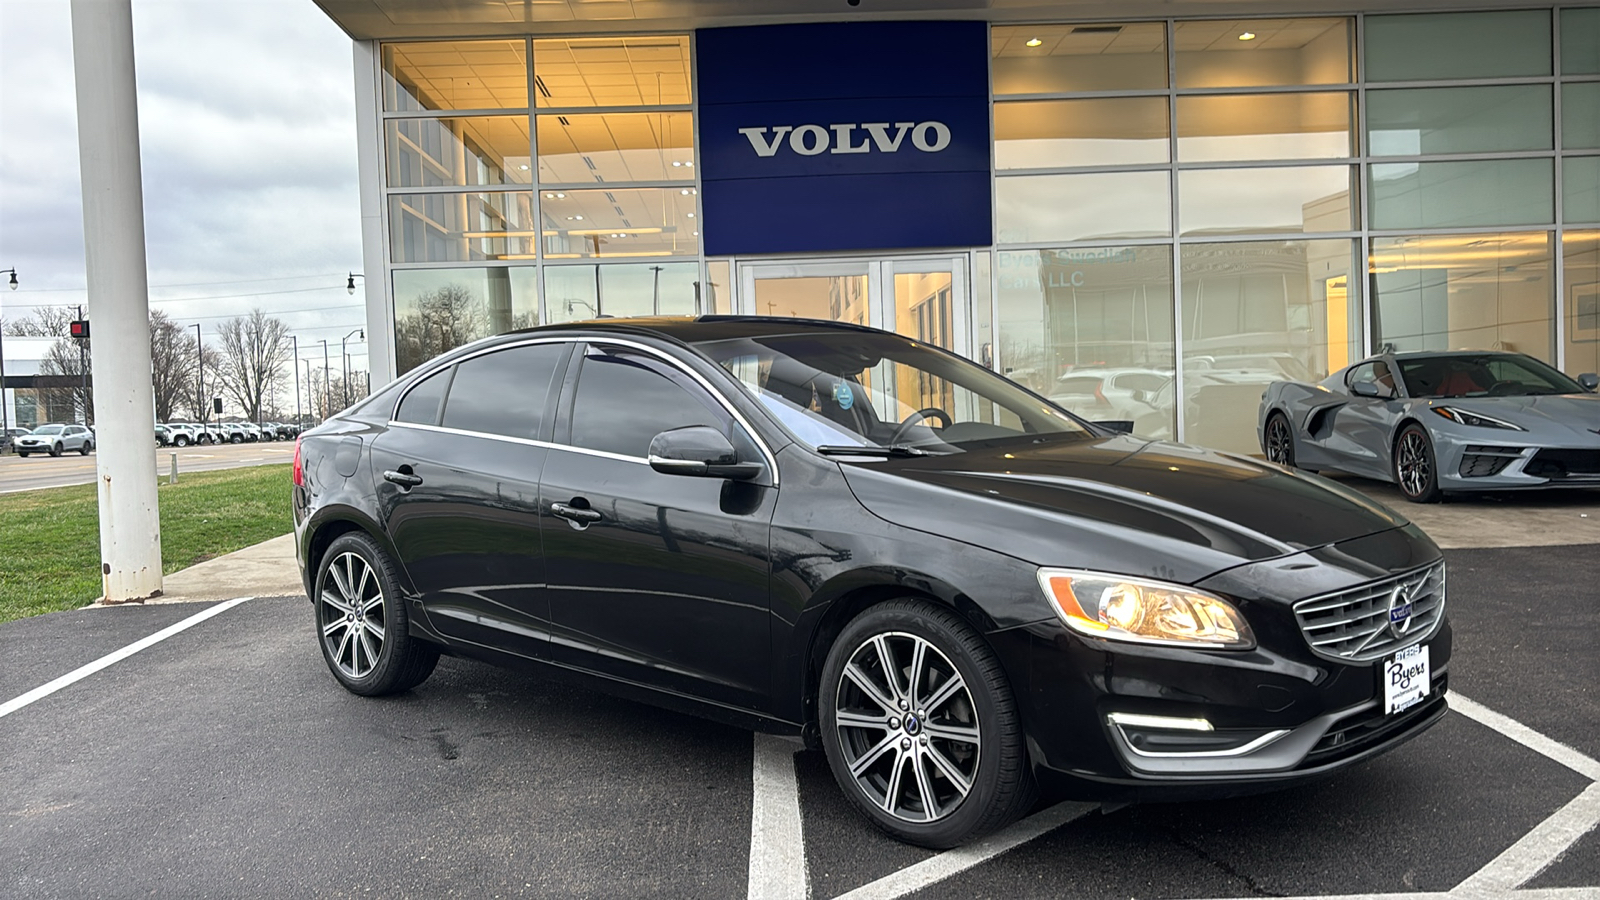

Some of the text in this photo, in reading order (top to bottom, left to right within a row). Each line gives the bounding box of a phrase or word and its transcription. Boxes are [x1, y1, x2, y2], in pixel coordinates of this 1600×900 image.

[738, 121, 951, 157] VOLVO
[999, 247, 1137, 270] Byers Swedish
[1048, 271, 1084, 288] LLC
[1387, 662, 1425, 689] Byers
